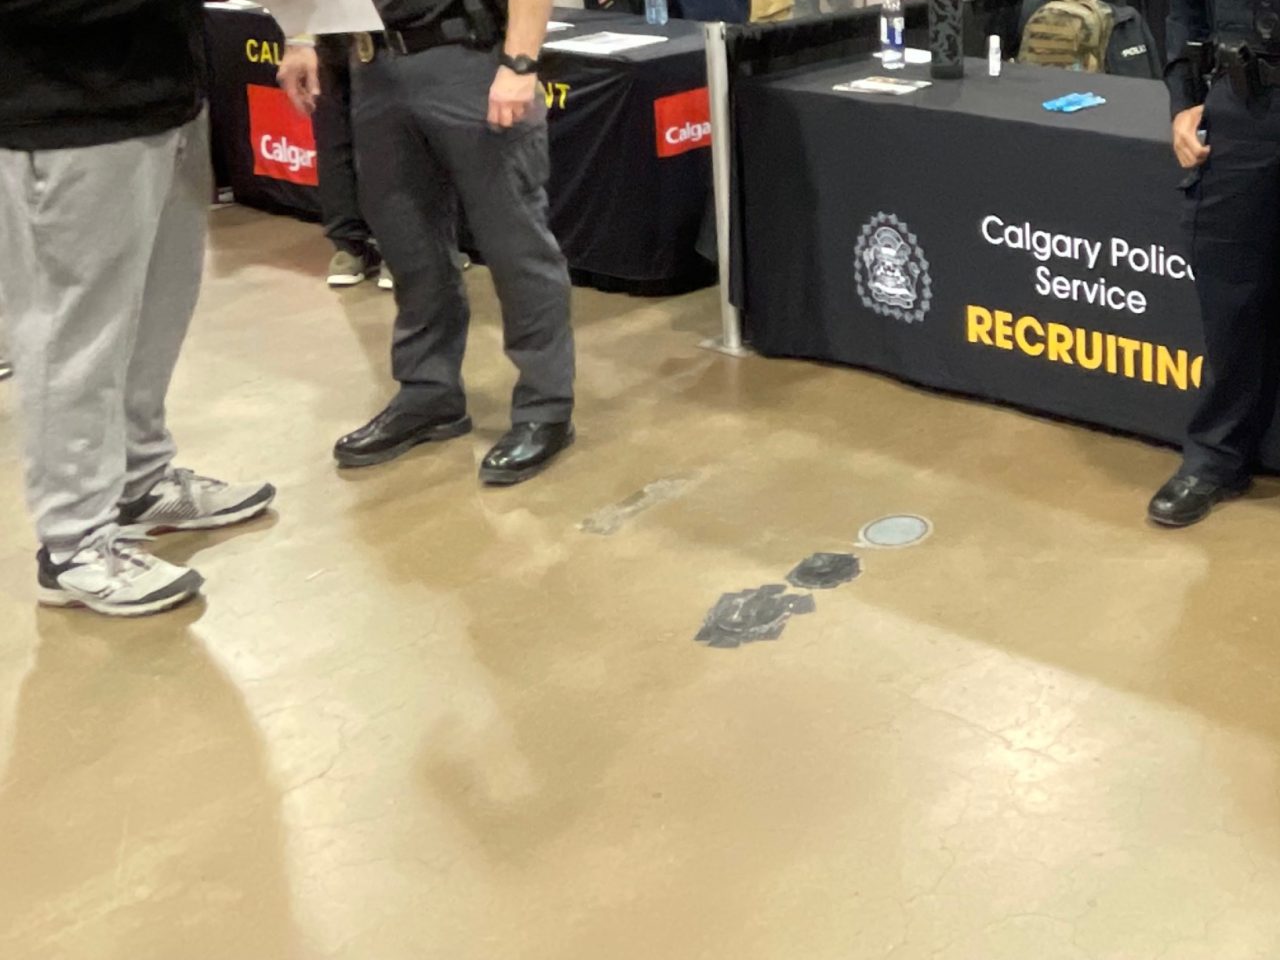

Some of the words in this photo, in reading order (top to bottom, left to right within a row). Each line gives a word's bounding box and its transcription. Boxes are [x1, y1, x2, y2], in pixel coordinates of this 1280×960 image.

[260, 134, 317, 172] Calgar
[665, 121, 711, 144] Calga
[981, 214, 1101, 269] Calgary
[1035, 266, 1147, 314] Service
